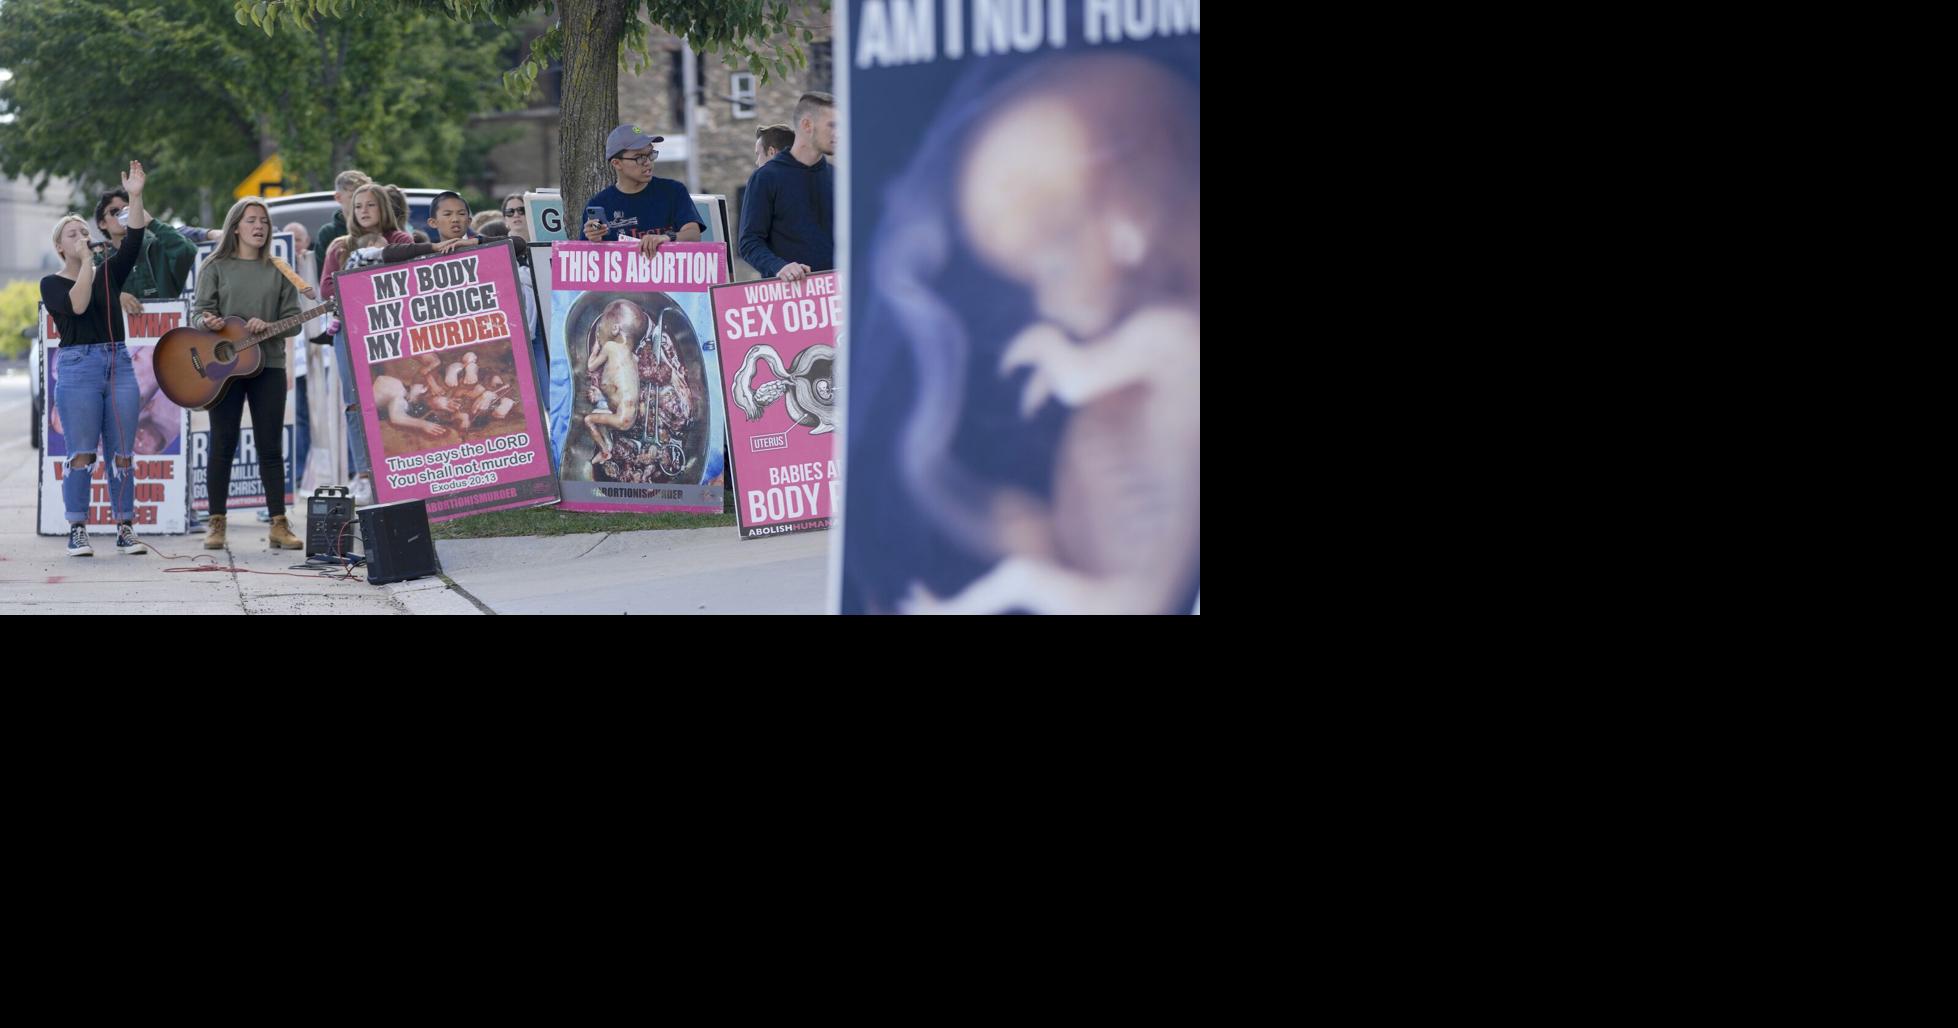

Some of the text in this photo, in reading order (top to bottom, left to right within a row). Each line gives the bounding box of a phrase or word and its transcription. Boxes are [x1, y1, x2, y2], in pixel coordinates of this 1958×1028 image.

[373, 256, 478, 300] MY BODY
[558, 251, 719, 285] THIS IS ABORTION
[367, 285, 498, 331] MY CHOICE
[744, 280, 802, 305] WOMEN
[805, 275, 836, 297] ARE
[128, 312, 182, 339] WHAT
[366, 313, 509, 361] MY MURDER
[724, 303, 778, 340] SEX
[387, 434, 529, 471] Thus says the LORD
[754, 436, 784, 448] UTERUS
[388, 451, 534, 489] You shall not murder
[431, 472, 497, 494] Exodus 20:13
[769, 461, 823, 485] BABIES
[747, 482, 820, 523] BODY
